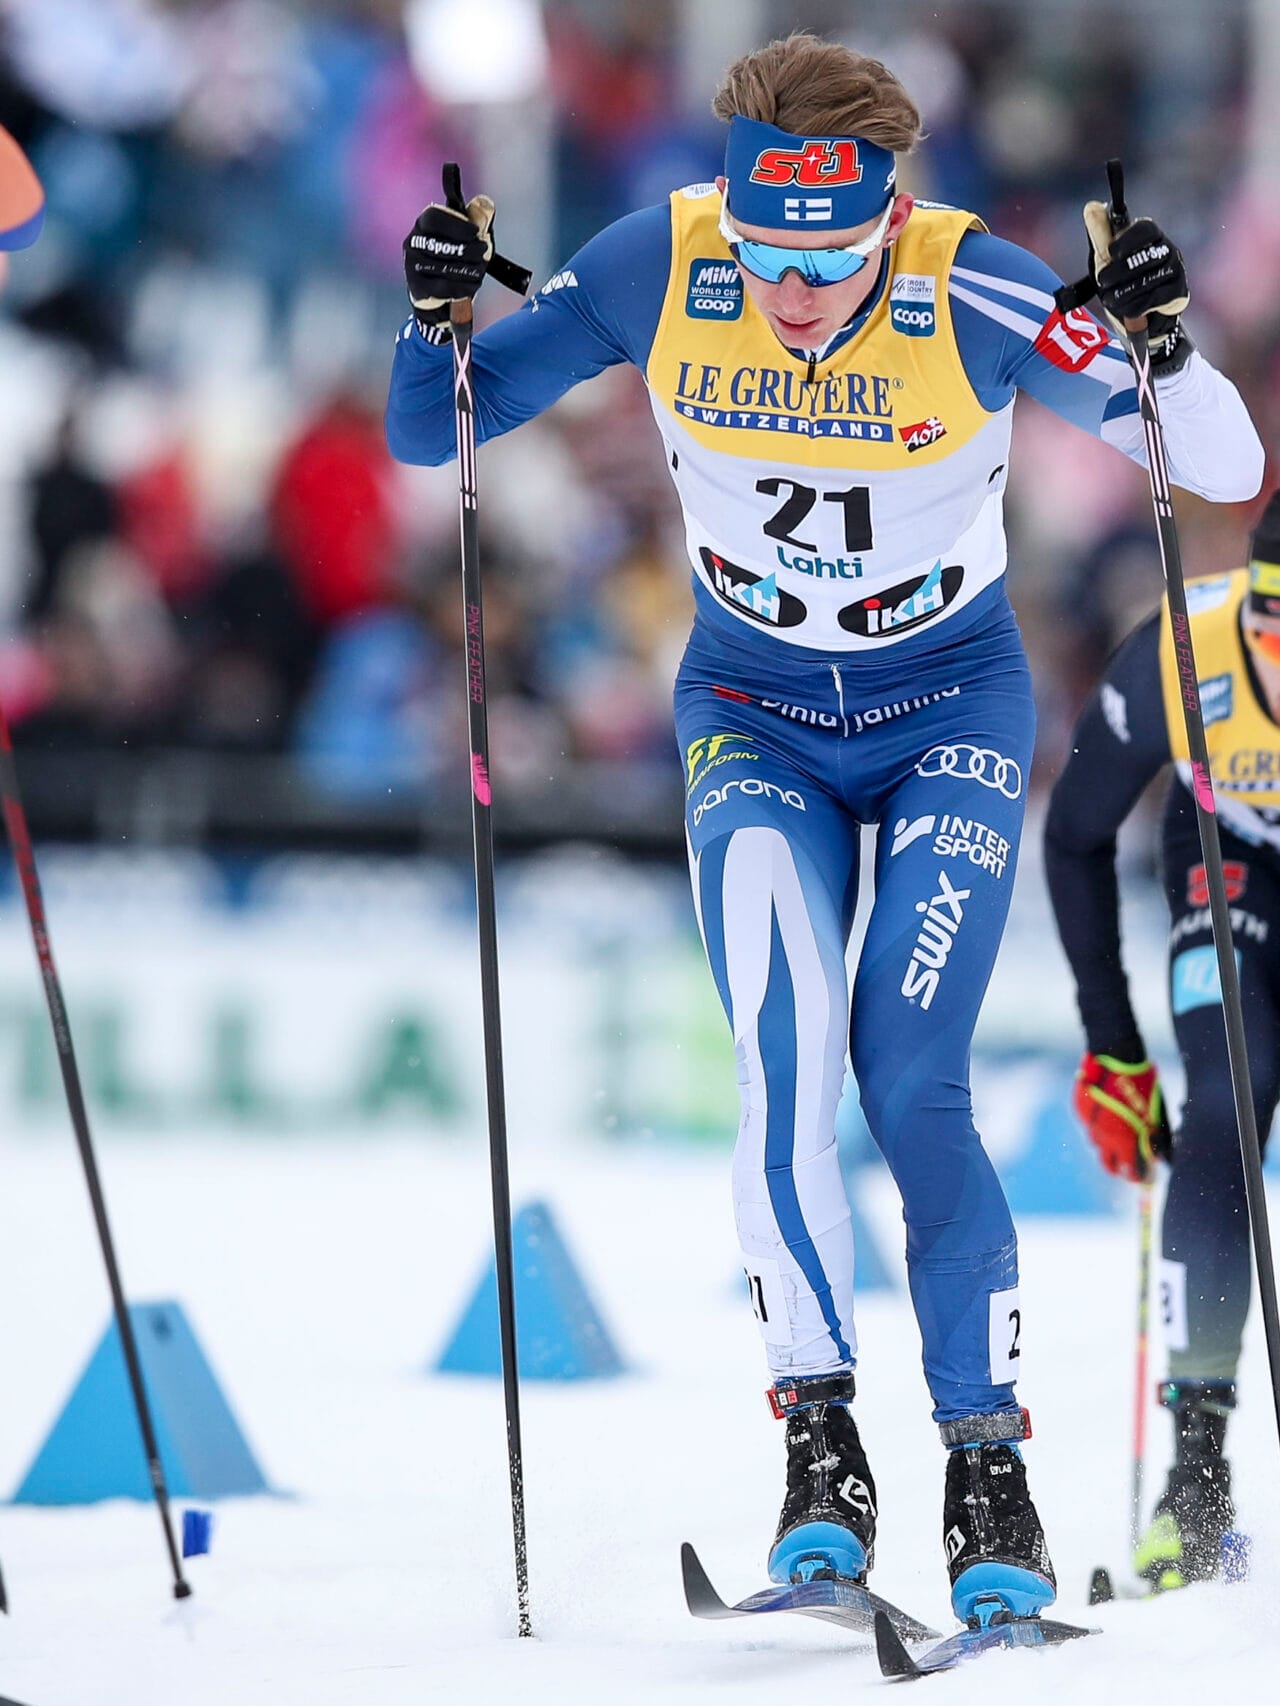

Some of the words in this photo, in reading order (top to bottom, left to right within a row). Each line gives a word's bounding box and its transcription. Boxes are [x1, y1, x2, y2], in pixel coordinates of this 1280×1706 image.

[691, 286, 721, 296] WORLD
[694, 299, 735, 313] coop
[893, 308, 934, 328] coop
[675, 361, 722, 402] LE
[683, 406, 883, 440] SWITZERLAND
[755, 477, 874, 553] 21
[776, 546, 864, 579] Lahti
[467, 603, 482, 636] PINK
[1172, 611, 1188, 645] PINK
[467, 639, 484, 705] FEATHER
[1178, 647, 1199, 712] FEATHER
[939, 814, 1011, 862] INTER
[932, 835, 1007, 879] SPORT
